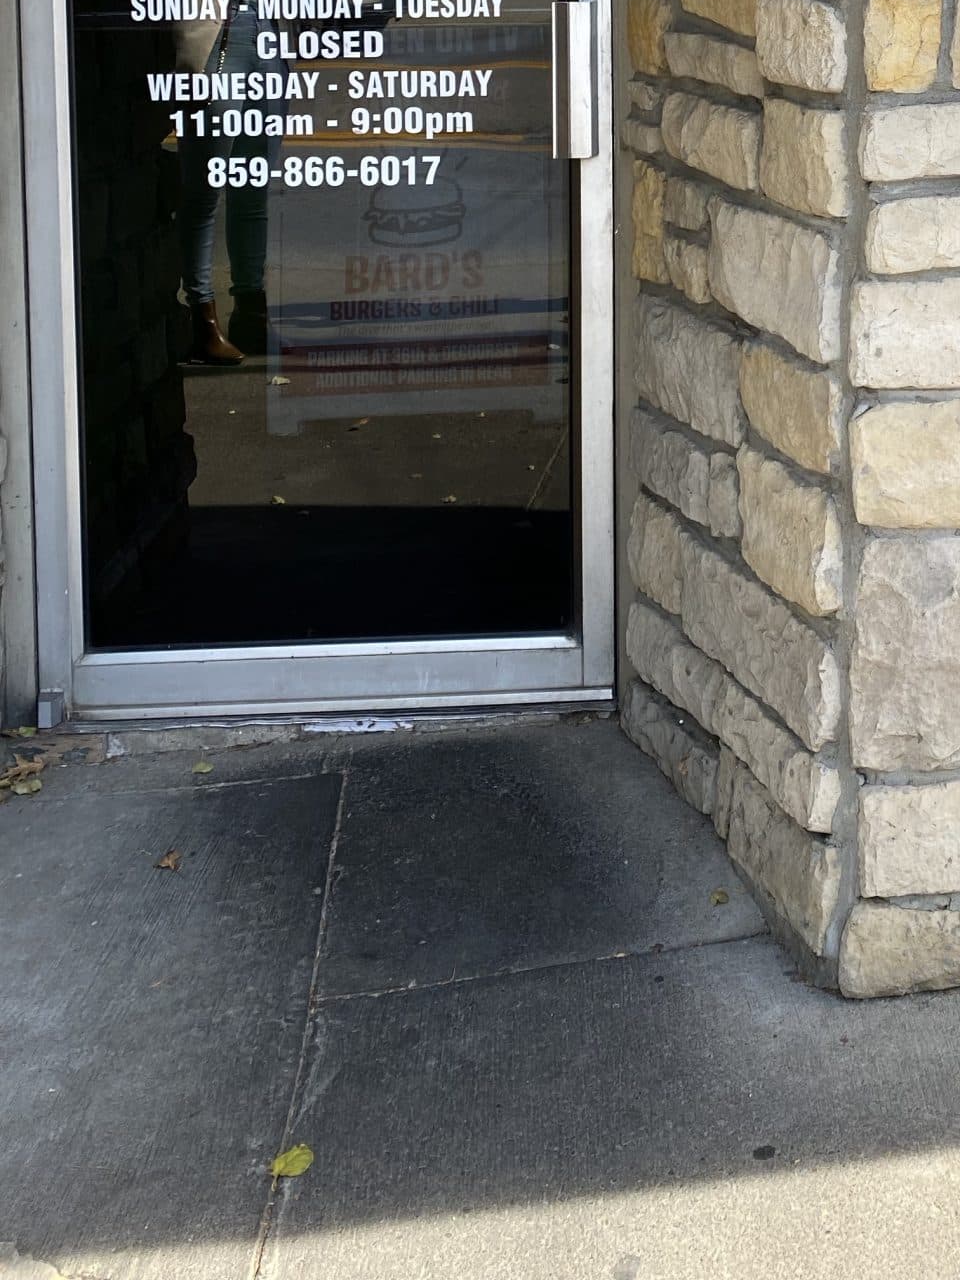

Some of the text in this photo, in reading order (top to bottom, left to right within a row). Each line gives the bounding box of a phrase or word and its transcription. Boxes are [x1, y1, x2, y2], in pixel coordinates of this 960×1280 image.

[256, 31, 384, 59] CLOSED
[147, 72, 320, 101] WEDNESDAY
[348, 70, 493, 99] SATURDAY
[169, 109, 314, 138] 11:00am
[351, 107, 473, 140] 9:00pm
[207, 156, 441, 188] 859-866-6017
[344, 248, 484, 295] BARD'S
[330, 298, 422, 320] BURGERS
